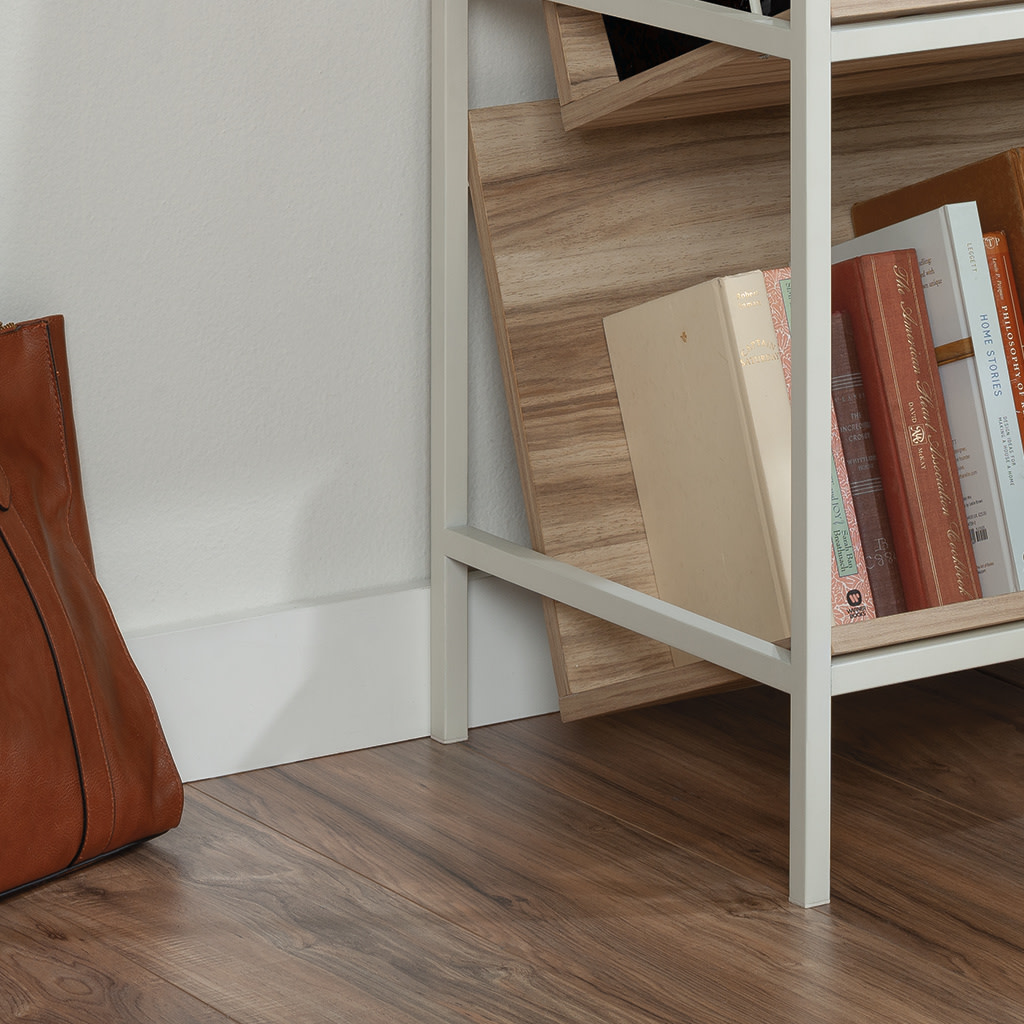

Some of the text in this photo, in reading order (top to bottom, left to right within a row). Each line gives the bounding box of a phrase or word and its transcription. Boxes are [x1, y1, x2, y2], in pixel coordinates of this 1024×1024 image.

[893, 264, 911, 295] The
[967, 242, 977, 273] LEGGETT
[741, 339, 776, 357] CAPTAIN
[900, 301, 921, 374] American
[980, 314, 1003, 397] HOME STORIES
[1001, 305, 1021, 378] PHILOSOPHY
[840, 422, 871, 432] INCRED
[916, 380, 938, 434] Heart
[908, 401, 917, 424] DAVID
[918, 447, 926, 470] McKAY
[927, 434, 952, 517] Association
[833, 530, 846, 572] Breathnach
[842, 530, 852, 551] Sarah
[946, 522, 974, 599] Cookbook
